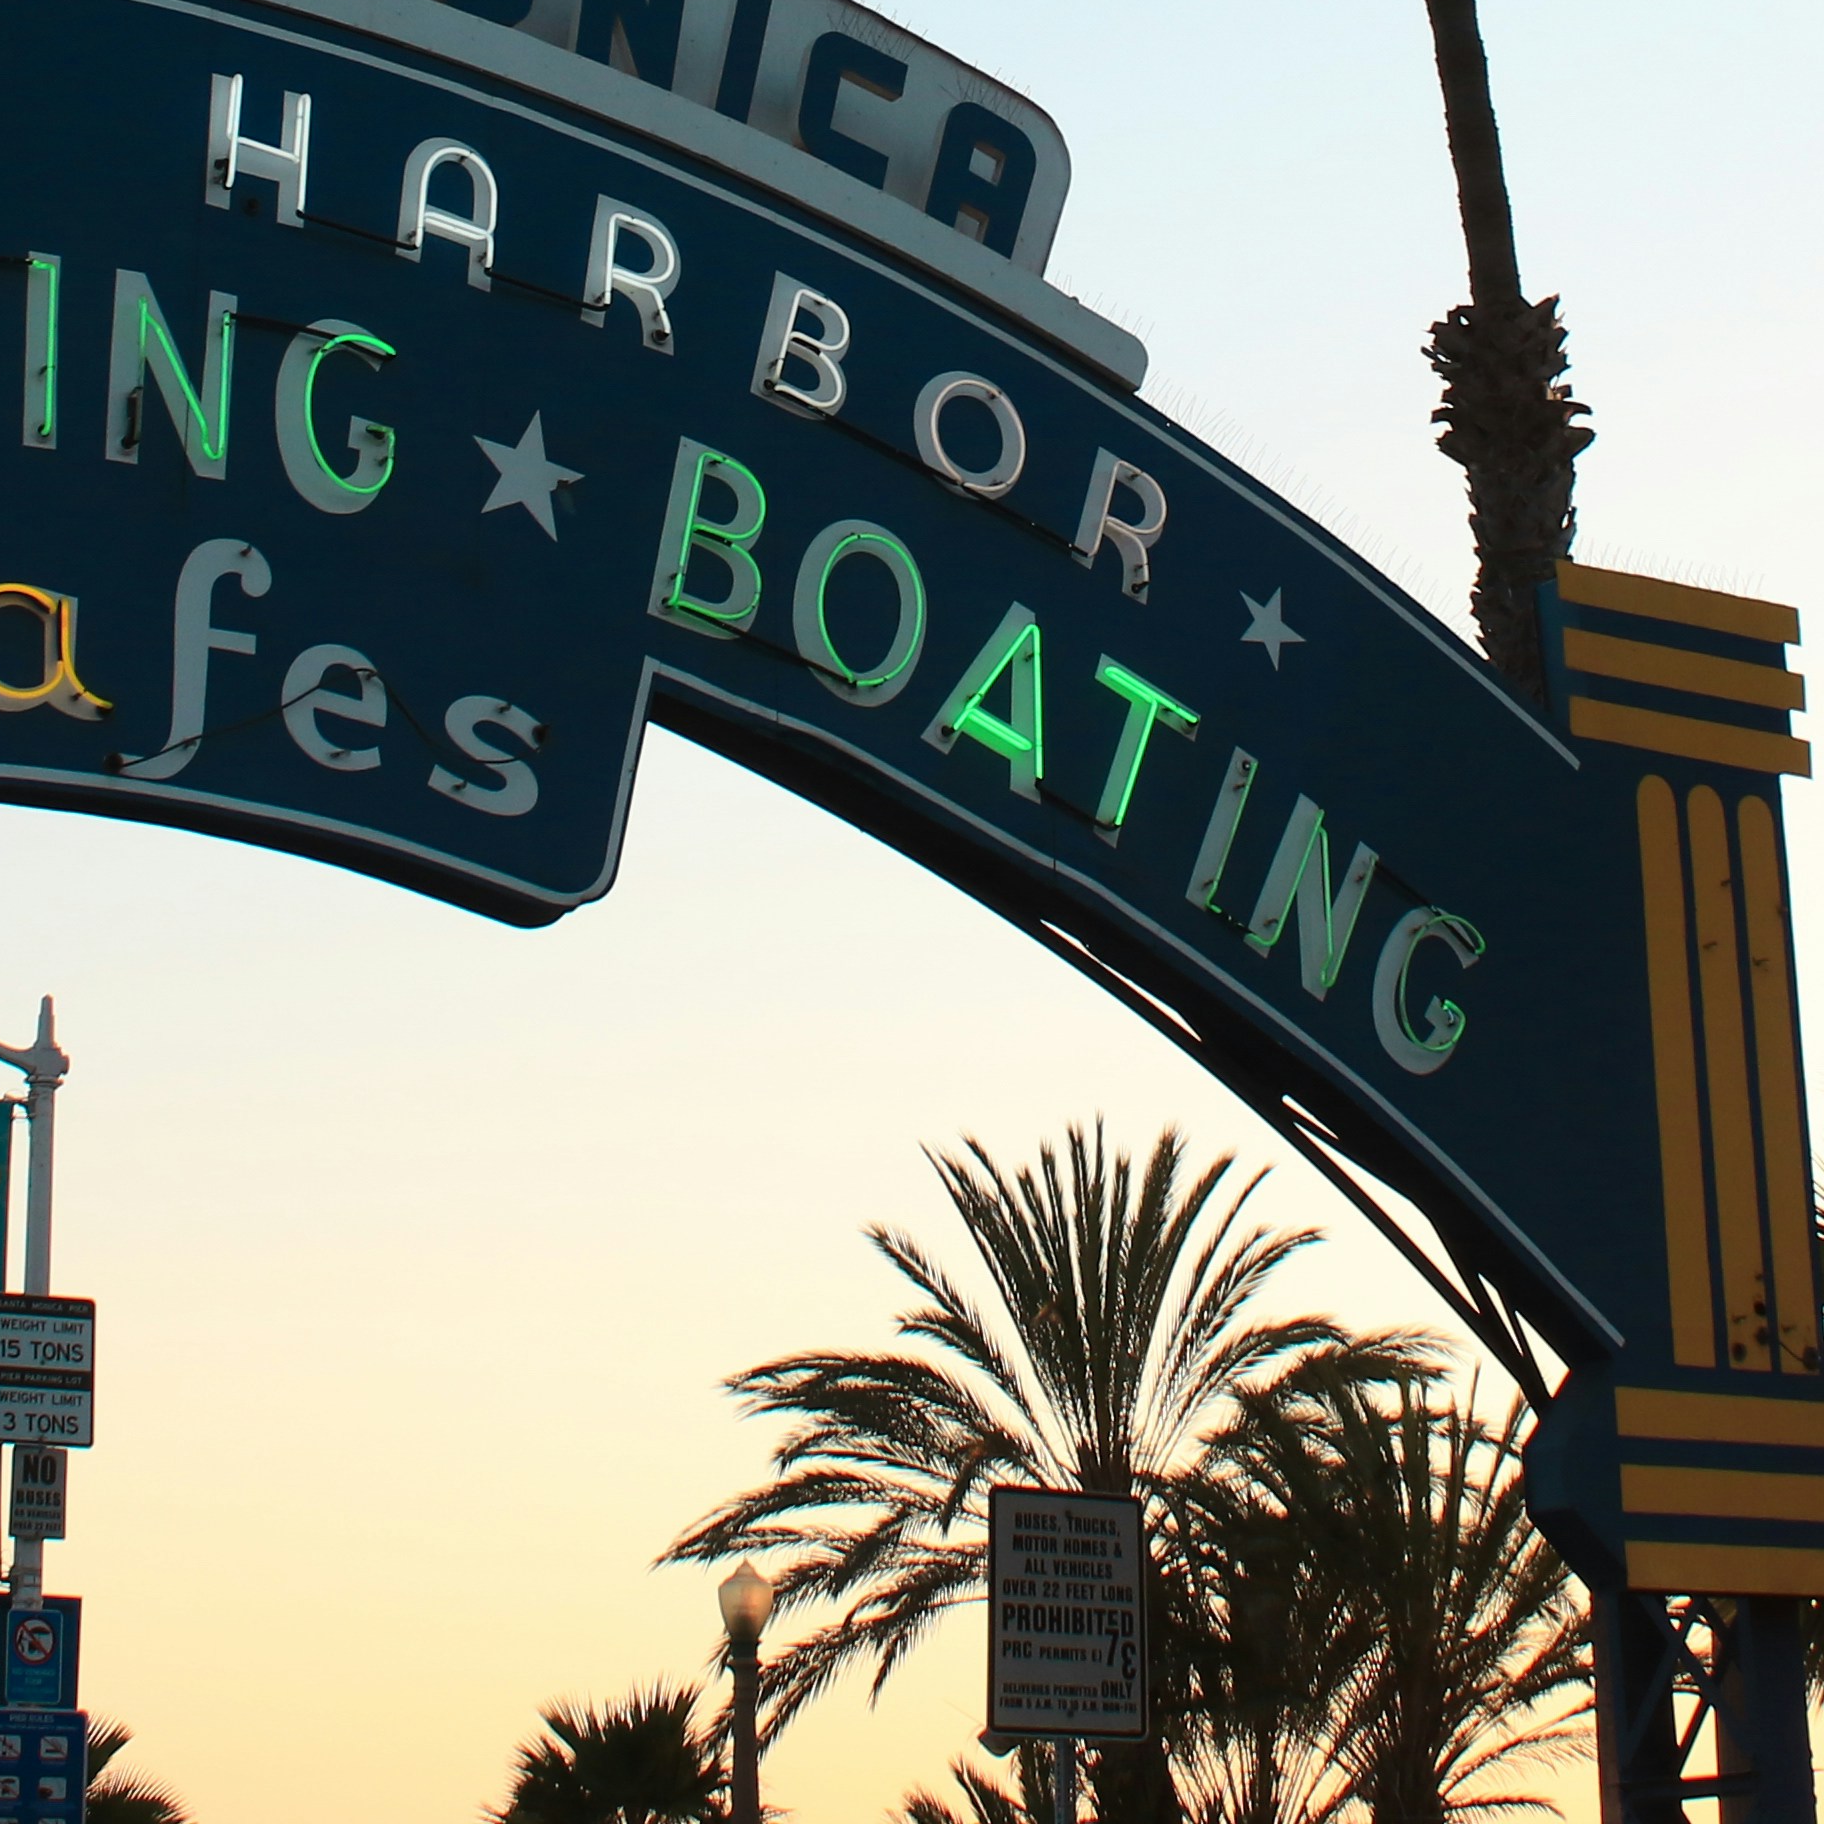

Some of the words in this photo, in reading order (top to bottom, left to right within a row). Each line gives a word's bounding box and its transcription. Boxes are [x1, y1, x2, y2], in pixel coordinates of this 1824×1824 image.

[205, 72, 1167, 605] HARBOR
[647, 435, 1486, 1074] BOATING
[0, 1318, 46, 1332] WEIGHT
[53, 1322, 85, 1335] LIMIT
[0, 1338, 21, 1358] 15
[30, 1340, 84, 1363] TONS
[0, 1371, 21, 1380] PIER
[24, 1373, 63, 1383] PARKING
[65, 1376, 83, 1385] LOT
[0, 1390, 45, 1404] WEIGHT
[51, 1394, 83, 1407] LIMIT
[3, 1412, 16, 1431] 3
[24, 1412, 79, 1435] TONS
[23, 1454, 56, 1486] NO
[16, 1489, 61, 1507] BUSES
[1014, 1511, 1061, 1533] BUSES,
[1067, 1515, 1120, 1537] TRUCKS,
[1012, 1534, 1057, 1553] MOTOR
[1063, 1538, 1107, 1557] HOMES
[1113, 1542, 1122, 1558] &
[1024, 1557, 1046, 1575] ALL
[1053, 1559, 1112, 1579] VEHICLES
[1002, 1578, 1036, 1596] OVER
[1043, 1580, 1060, 1598] 22
[1066, 1583, 1096, 1600] FEET
[1101, 1585, 1133, 1602] LONG
[1002, 1602, 1133, 1637] PROHIBITED
[1039, 1646, 1087, 1662] PERMITS
[1002, 1682, 1050, 1696] DELIVERIES
[1054, 1684, 1098, 1697] PERMITTED
[1101, 1679, 1133, 1699] ONLY
[999, 1696, 1023, 1707] FROM
